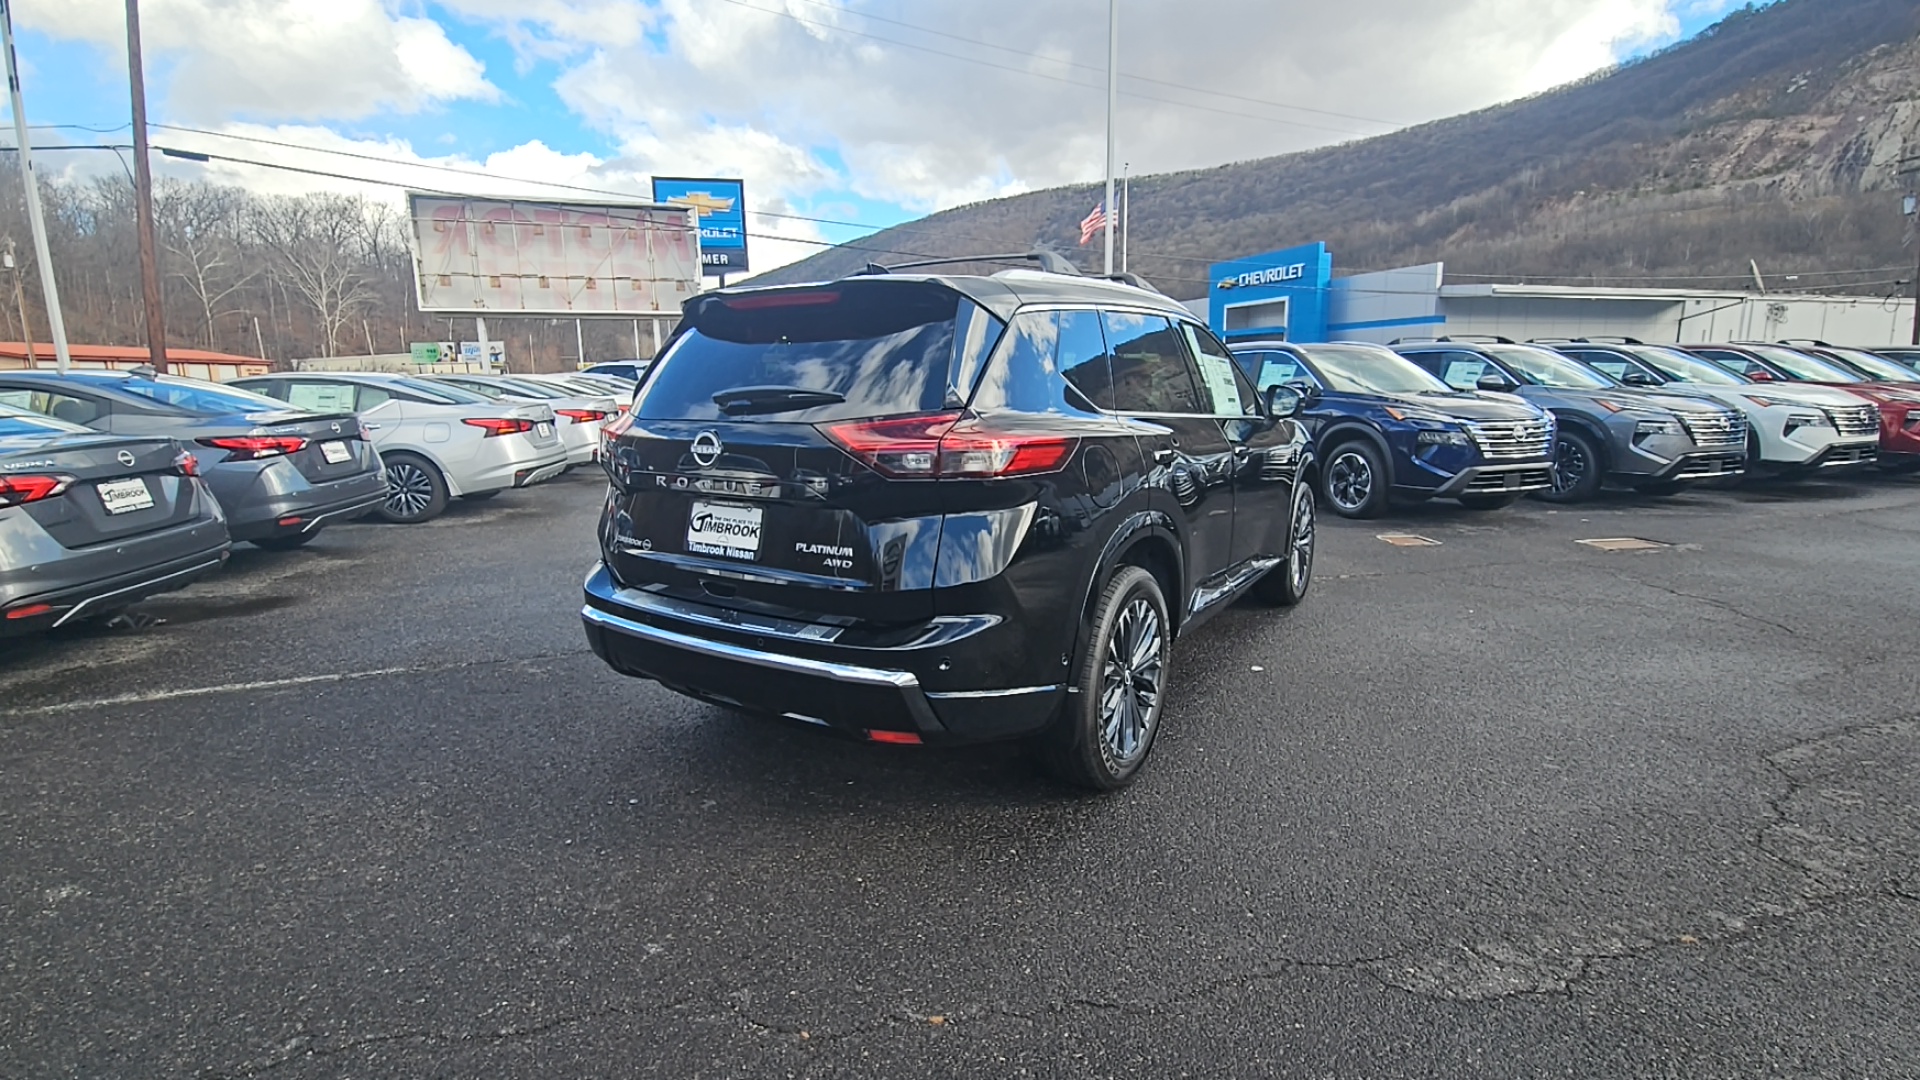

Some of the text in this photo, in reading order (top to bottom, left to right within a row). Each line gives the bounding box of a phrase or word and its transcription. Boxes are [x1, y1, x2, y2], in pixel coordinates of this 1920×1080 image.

[1239, 263, 1306, 287] CHEVROLET
[655, 475, 763, 496] ROGUE
[102, 488, 147, 503] TIMBROOK
[691, 511, 761, 539] TIMBROOK
[688, 541, 755, 560] Timbrook Nissan
[795, 542, 853, 557] PLATINUM
[823, 558, 853, 569] AWD
